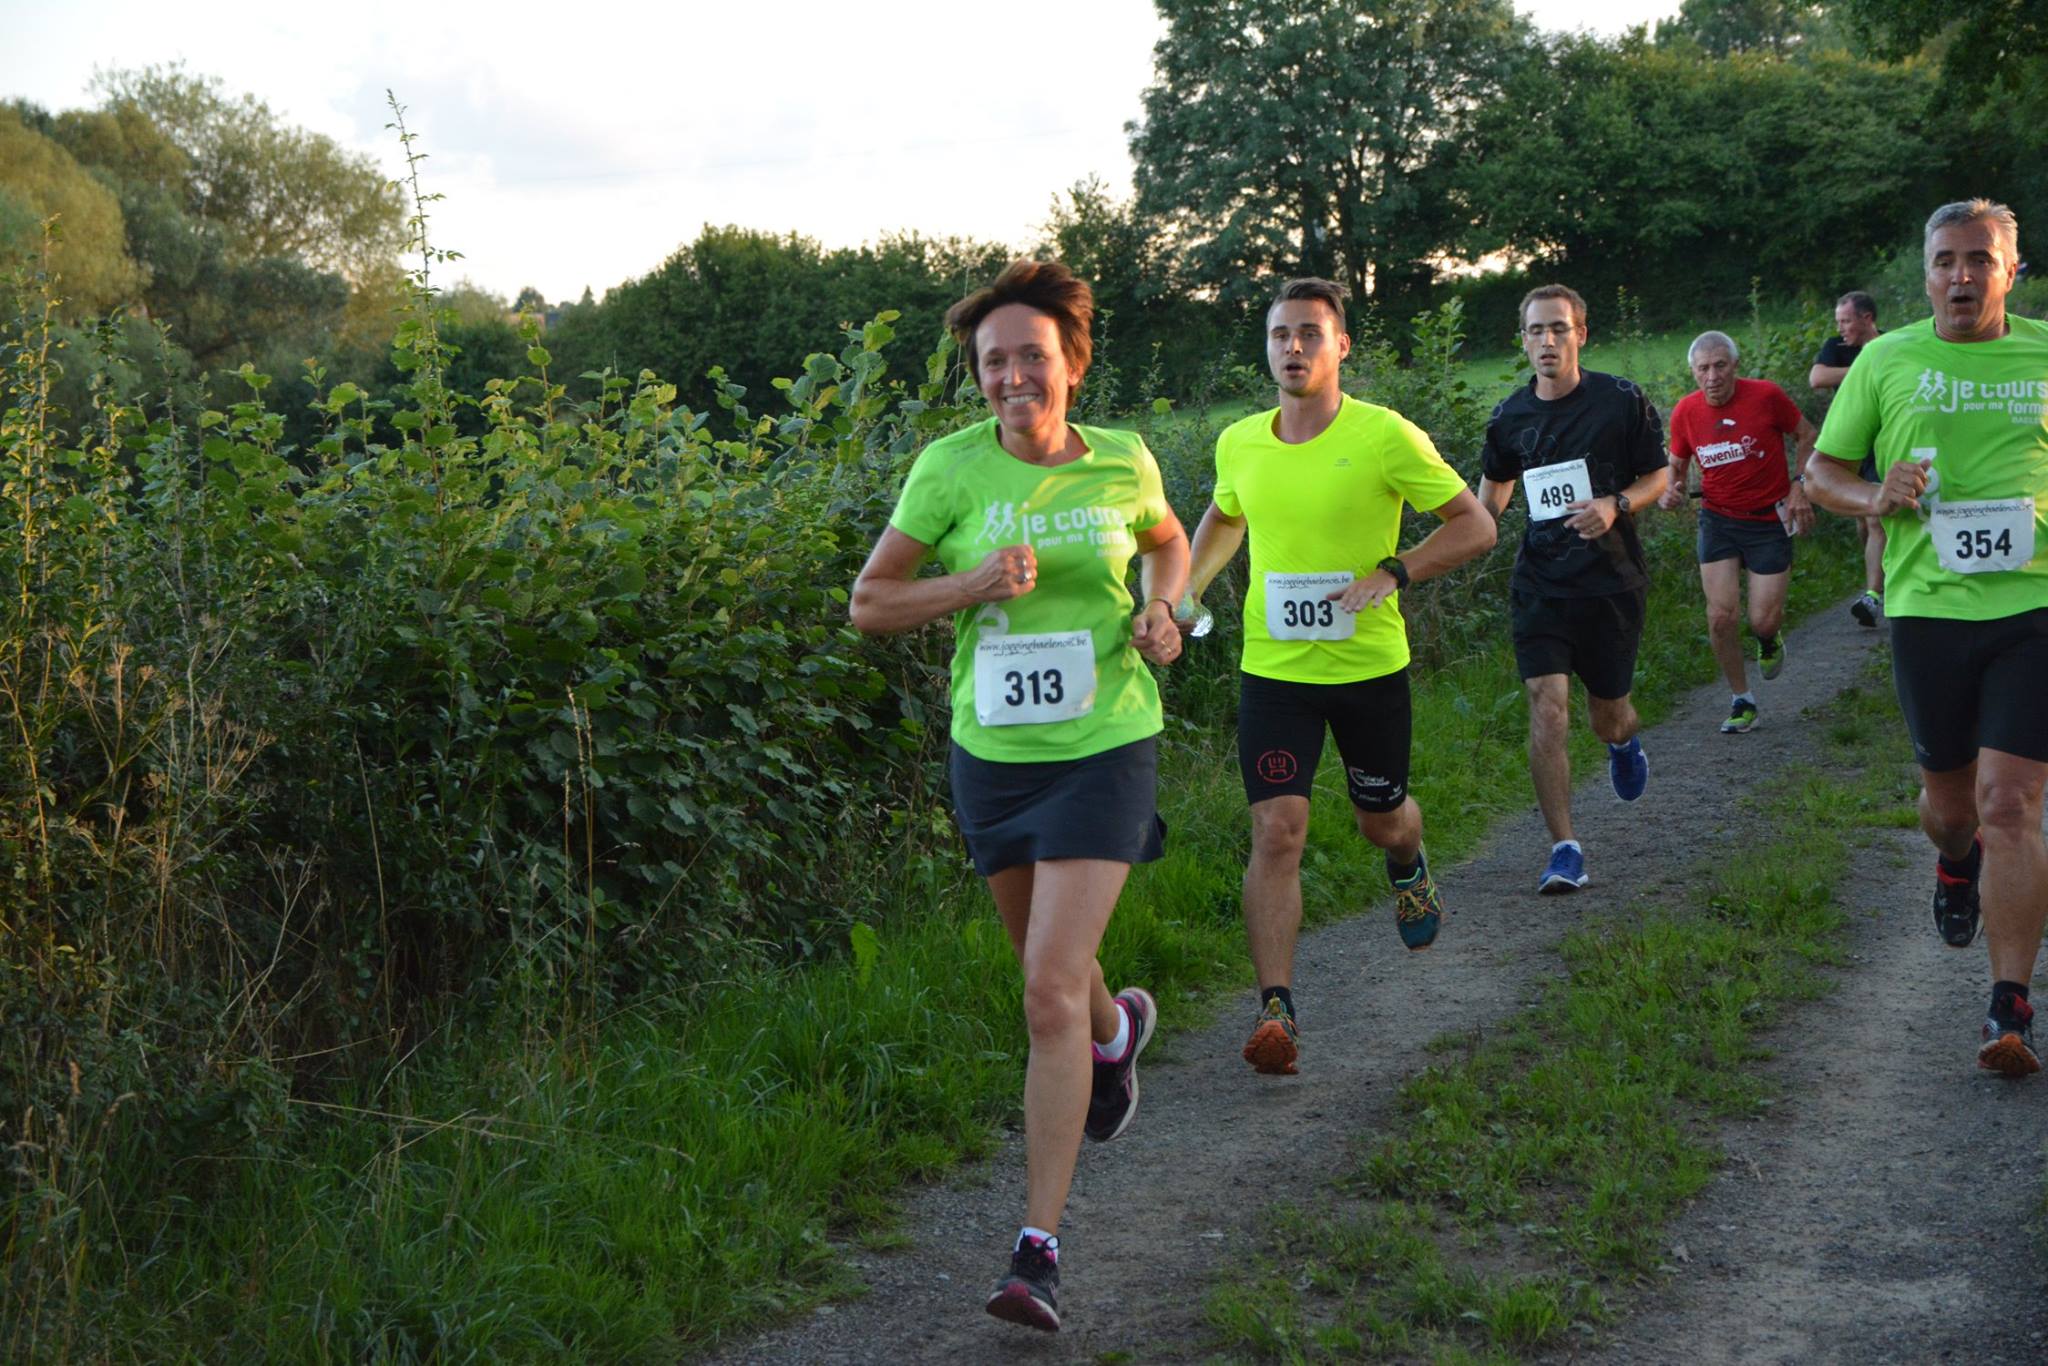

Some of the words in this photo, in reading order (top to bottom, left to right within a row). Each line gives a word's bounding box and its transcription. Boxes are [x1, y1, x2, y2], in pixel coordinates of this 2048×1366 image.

[1940, 376, 1974, 413] je
[1540, 483, 1576, 508] 489
[1956, 528, 2012, 559] 354
[1283, 599, 1334, 627] 303
[1004, 668, 1064, 707] 313
